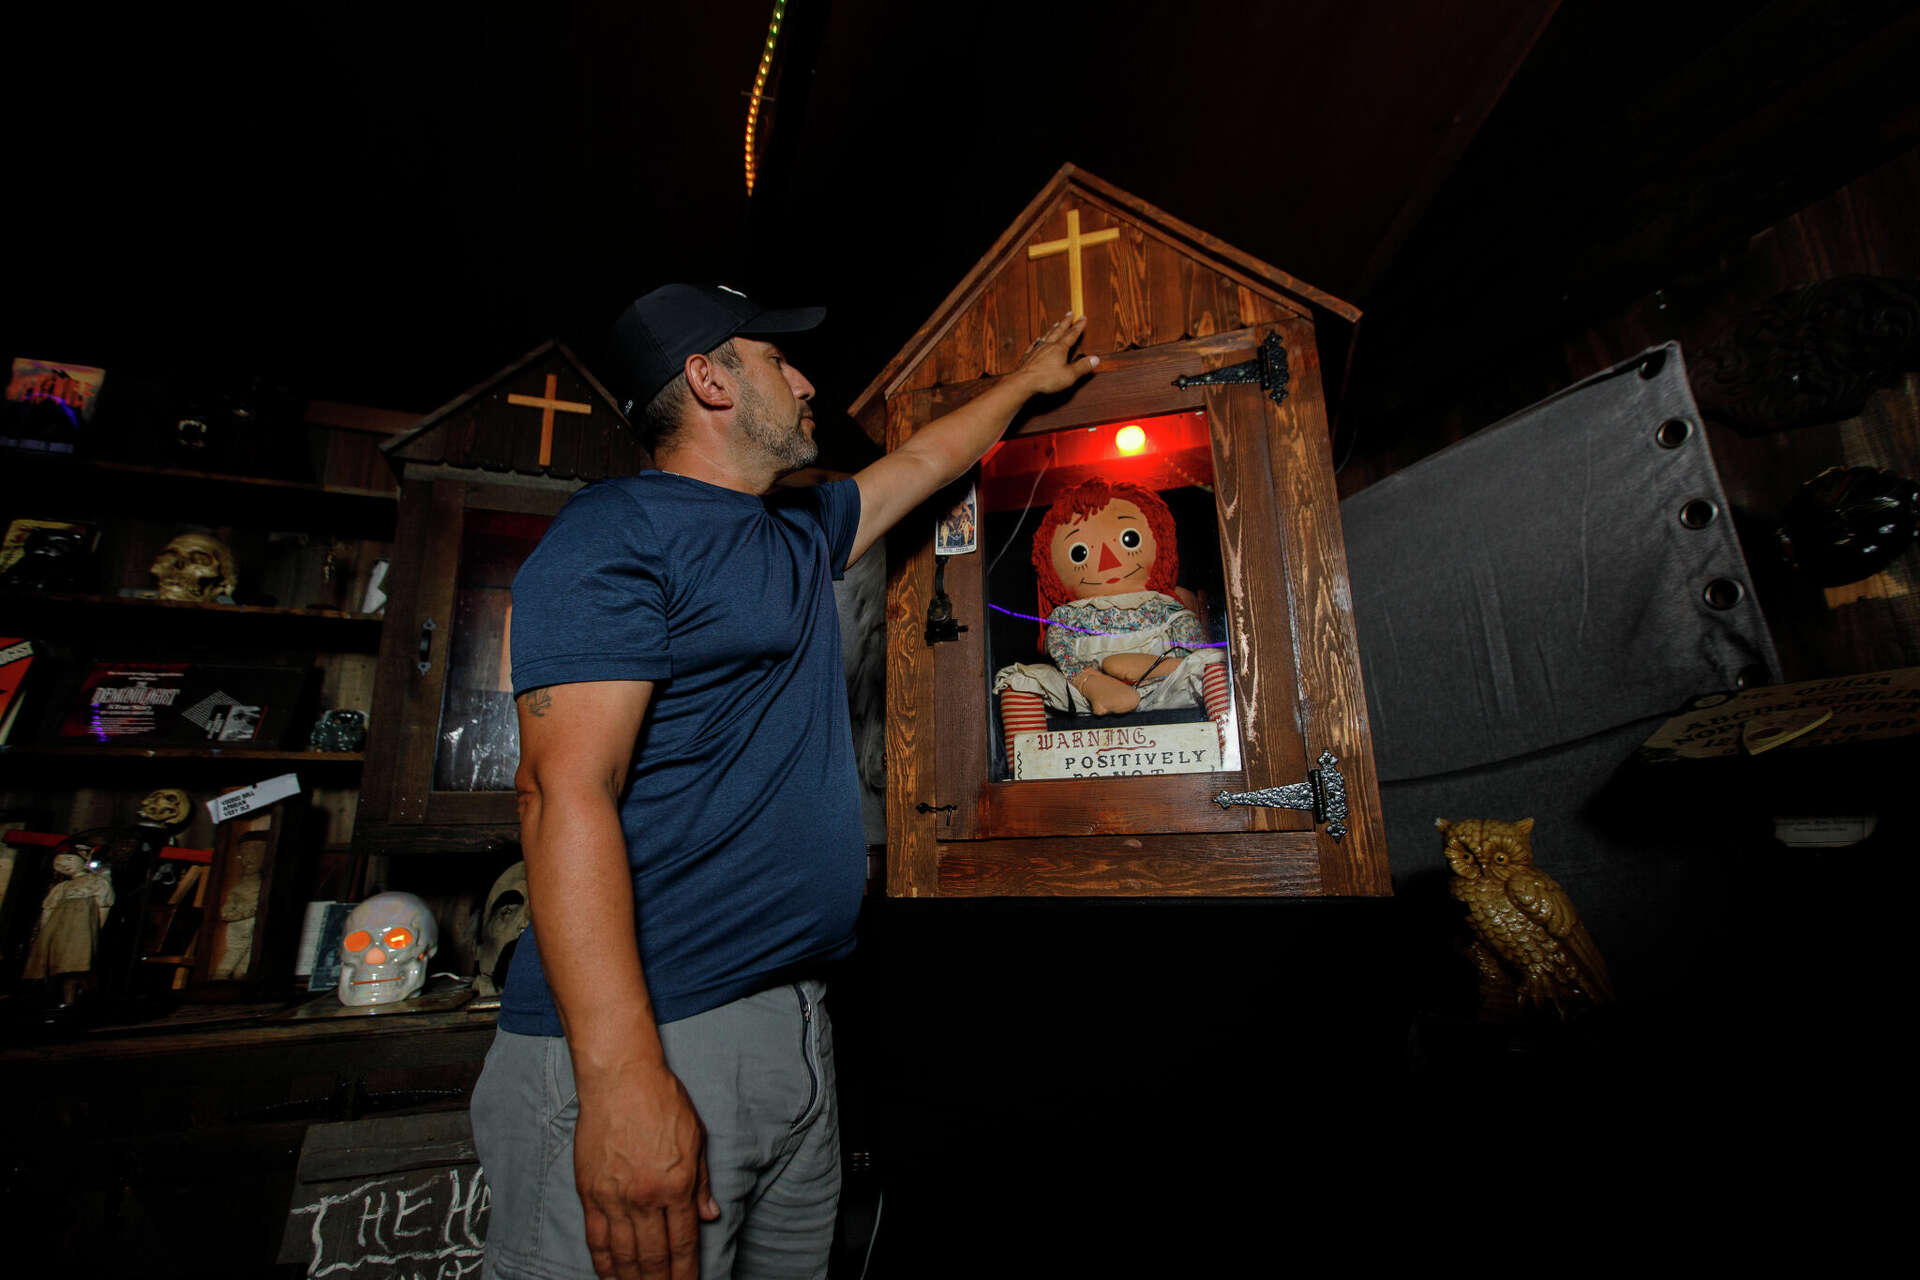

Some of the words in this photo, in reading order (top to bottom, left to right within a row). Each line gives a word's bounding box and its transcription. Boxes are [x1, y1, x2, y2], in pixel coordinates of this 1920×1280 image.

[1037, 727, 1148, 751] WARNING
[1065, 750, 1206, 770] POSITIVELY
[289, 1175, 446, 1276] THE
